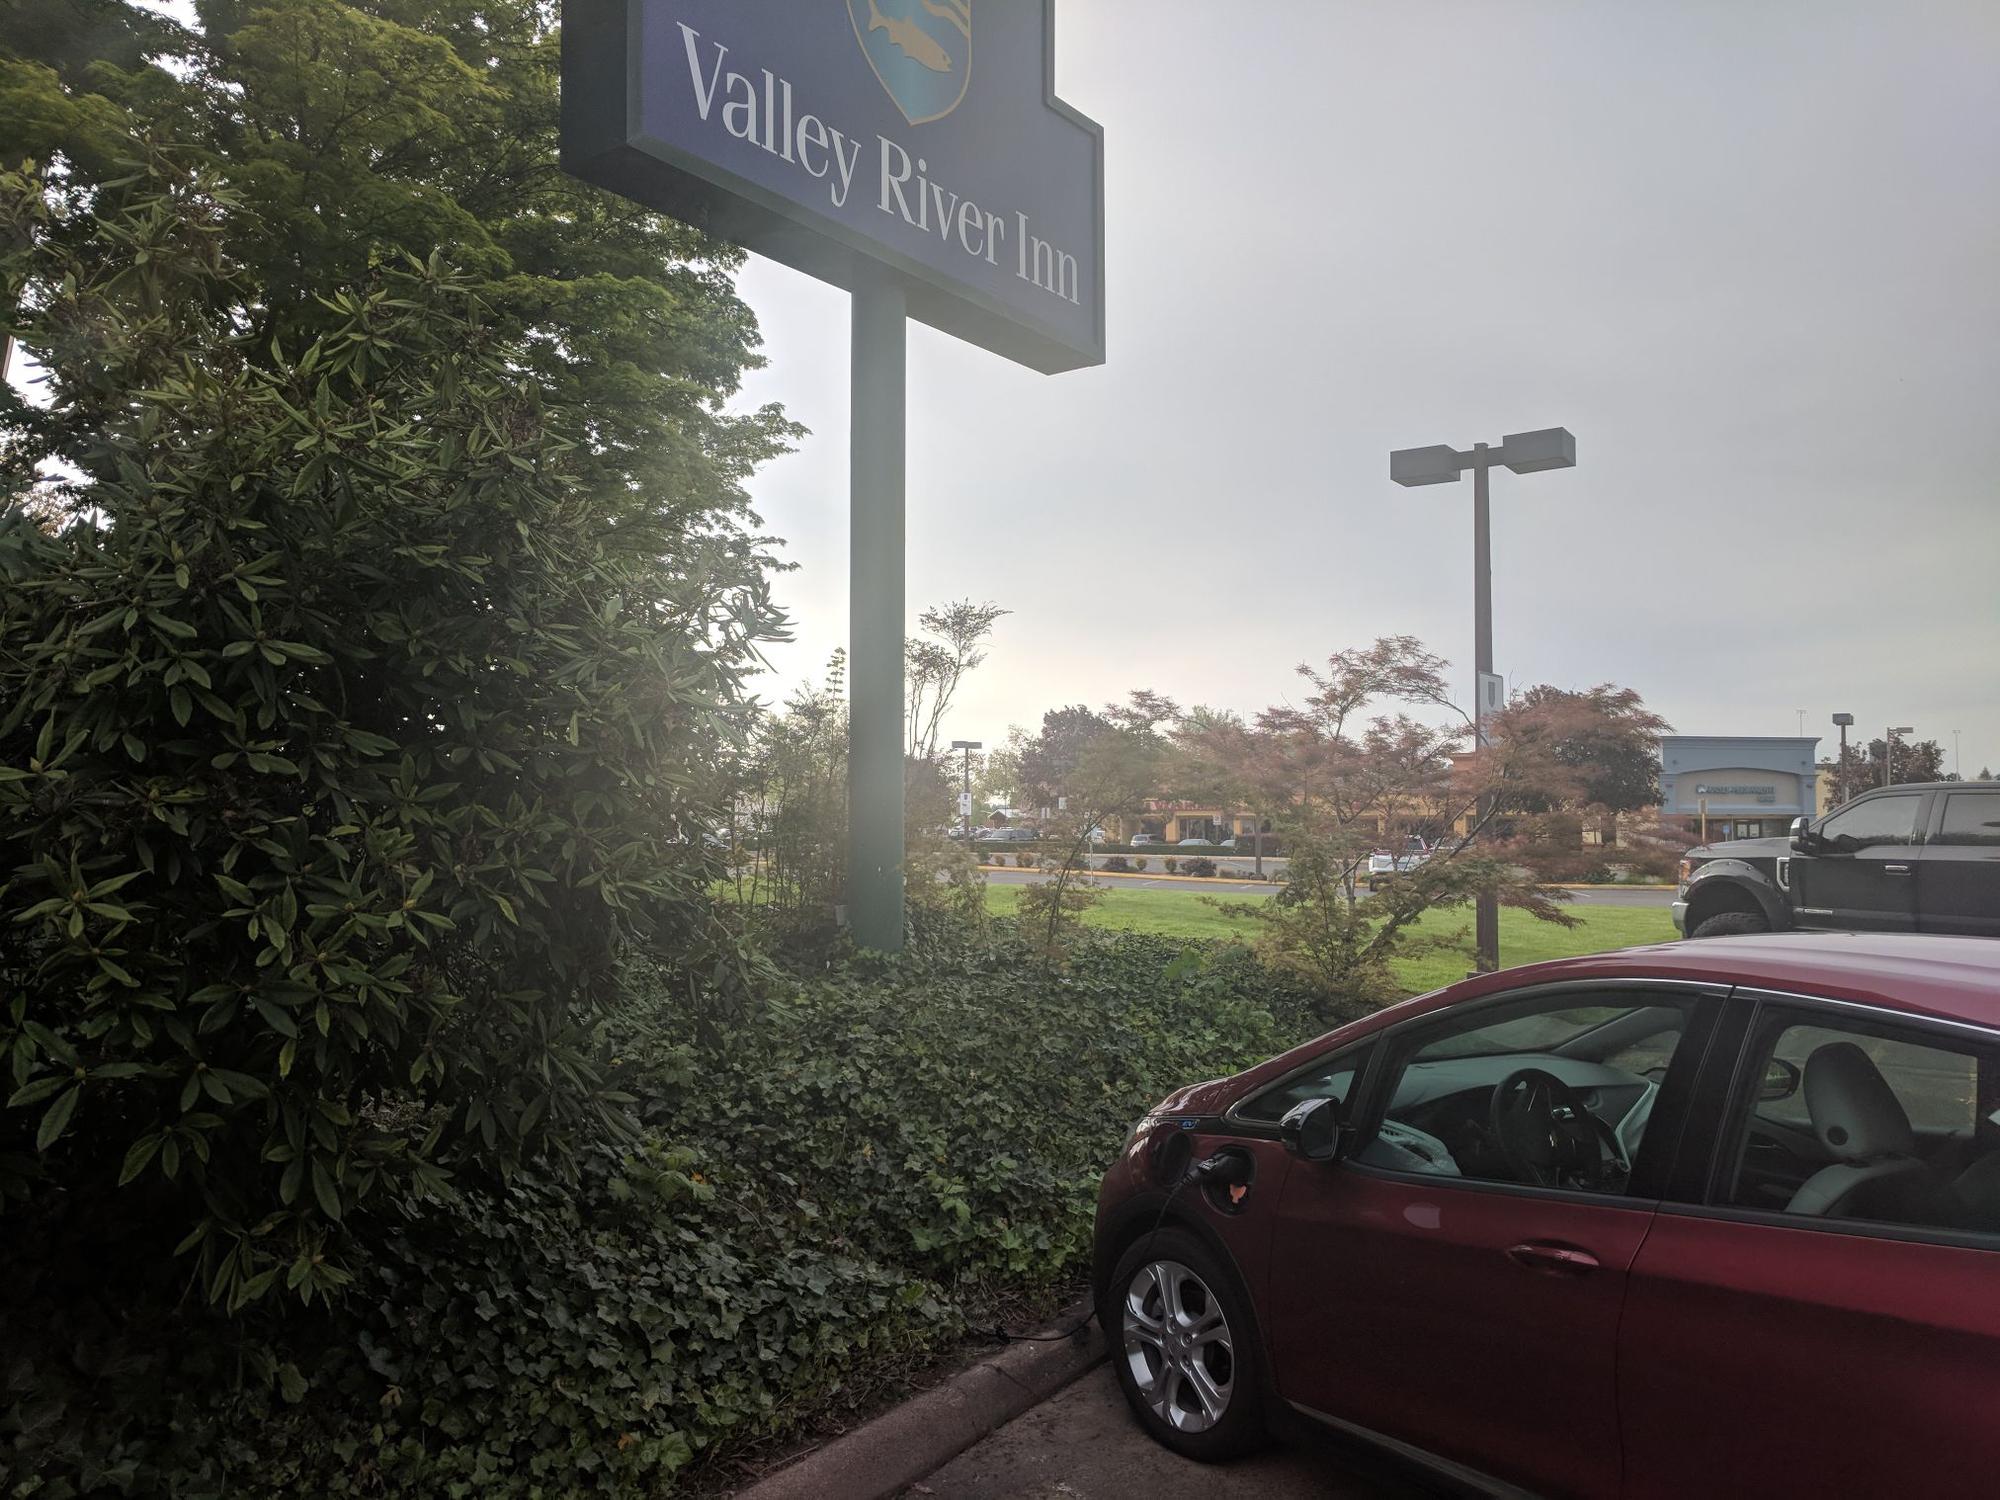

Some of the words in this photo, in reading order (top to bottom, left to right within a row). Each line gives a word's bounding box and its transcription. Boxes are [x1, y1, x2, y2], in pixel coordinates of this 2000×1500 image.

[676, 21, 861, 207] Valley
[876, 135, 1005, 266] River
[1015, 210, 1080, 305] Inn
